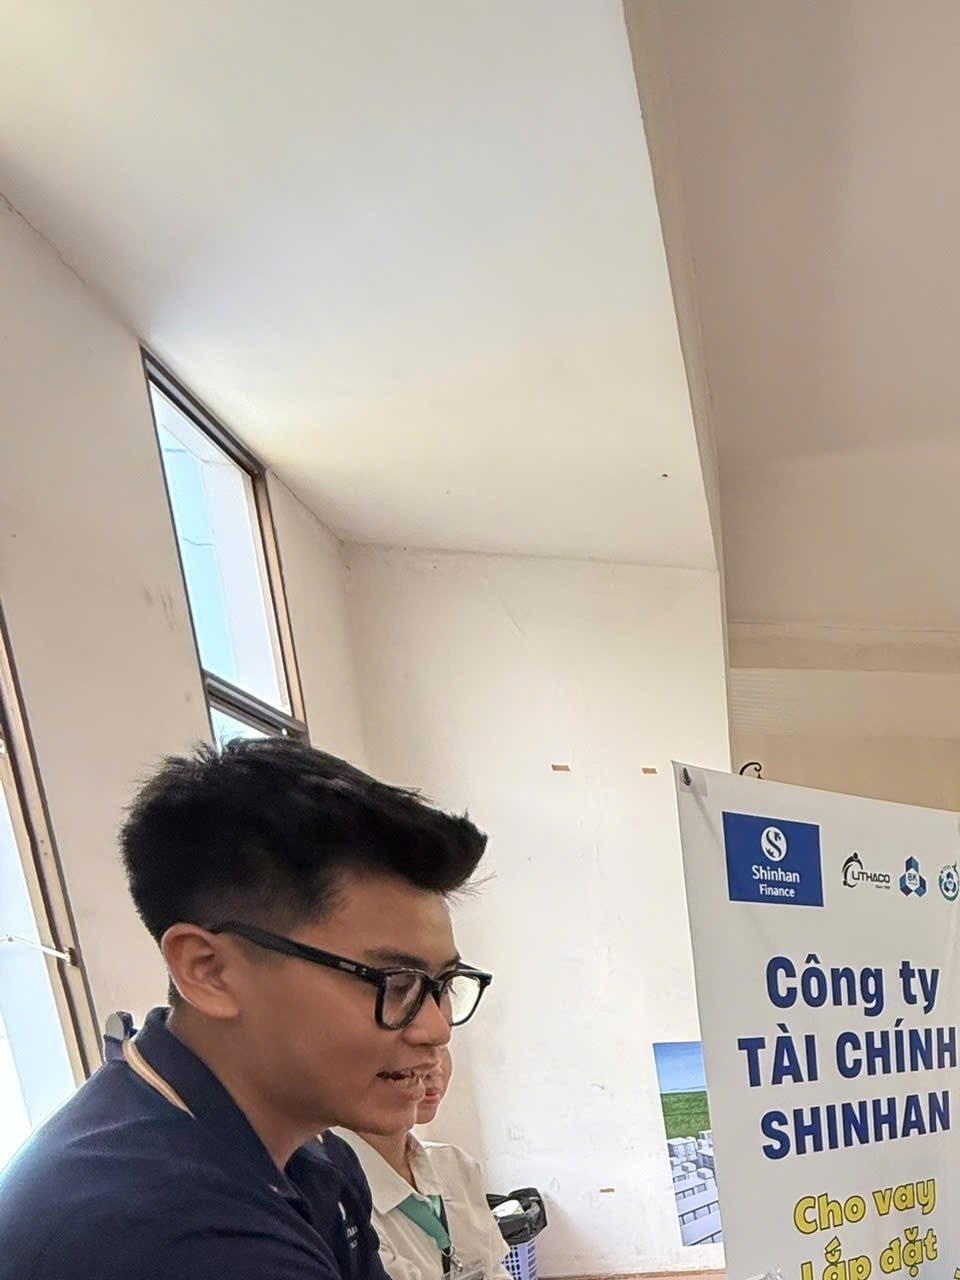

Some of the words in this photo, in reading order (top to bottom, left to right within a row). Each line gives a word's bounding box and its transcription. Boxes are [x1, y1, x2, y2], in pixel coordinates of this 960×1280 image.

[751, 864, 800, 883] Shinhan
[759, 883, 796, 898] Finance
[766, 953, 885, 1017] Công
[899, 960, 940, 1015] ty
[737, 1022, 819, 1087] TÀI
[835, 1018, 958, 1079] CHÍNH
[760, 1090, 951, 1160] SHINHAN
[793, 1193, 866, 1235] Cho
[872, 1178, 936, 1216] vay
